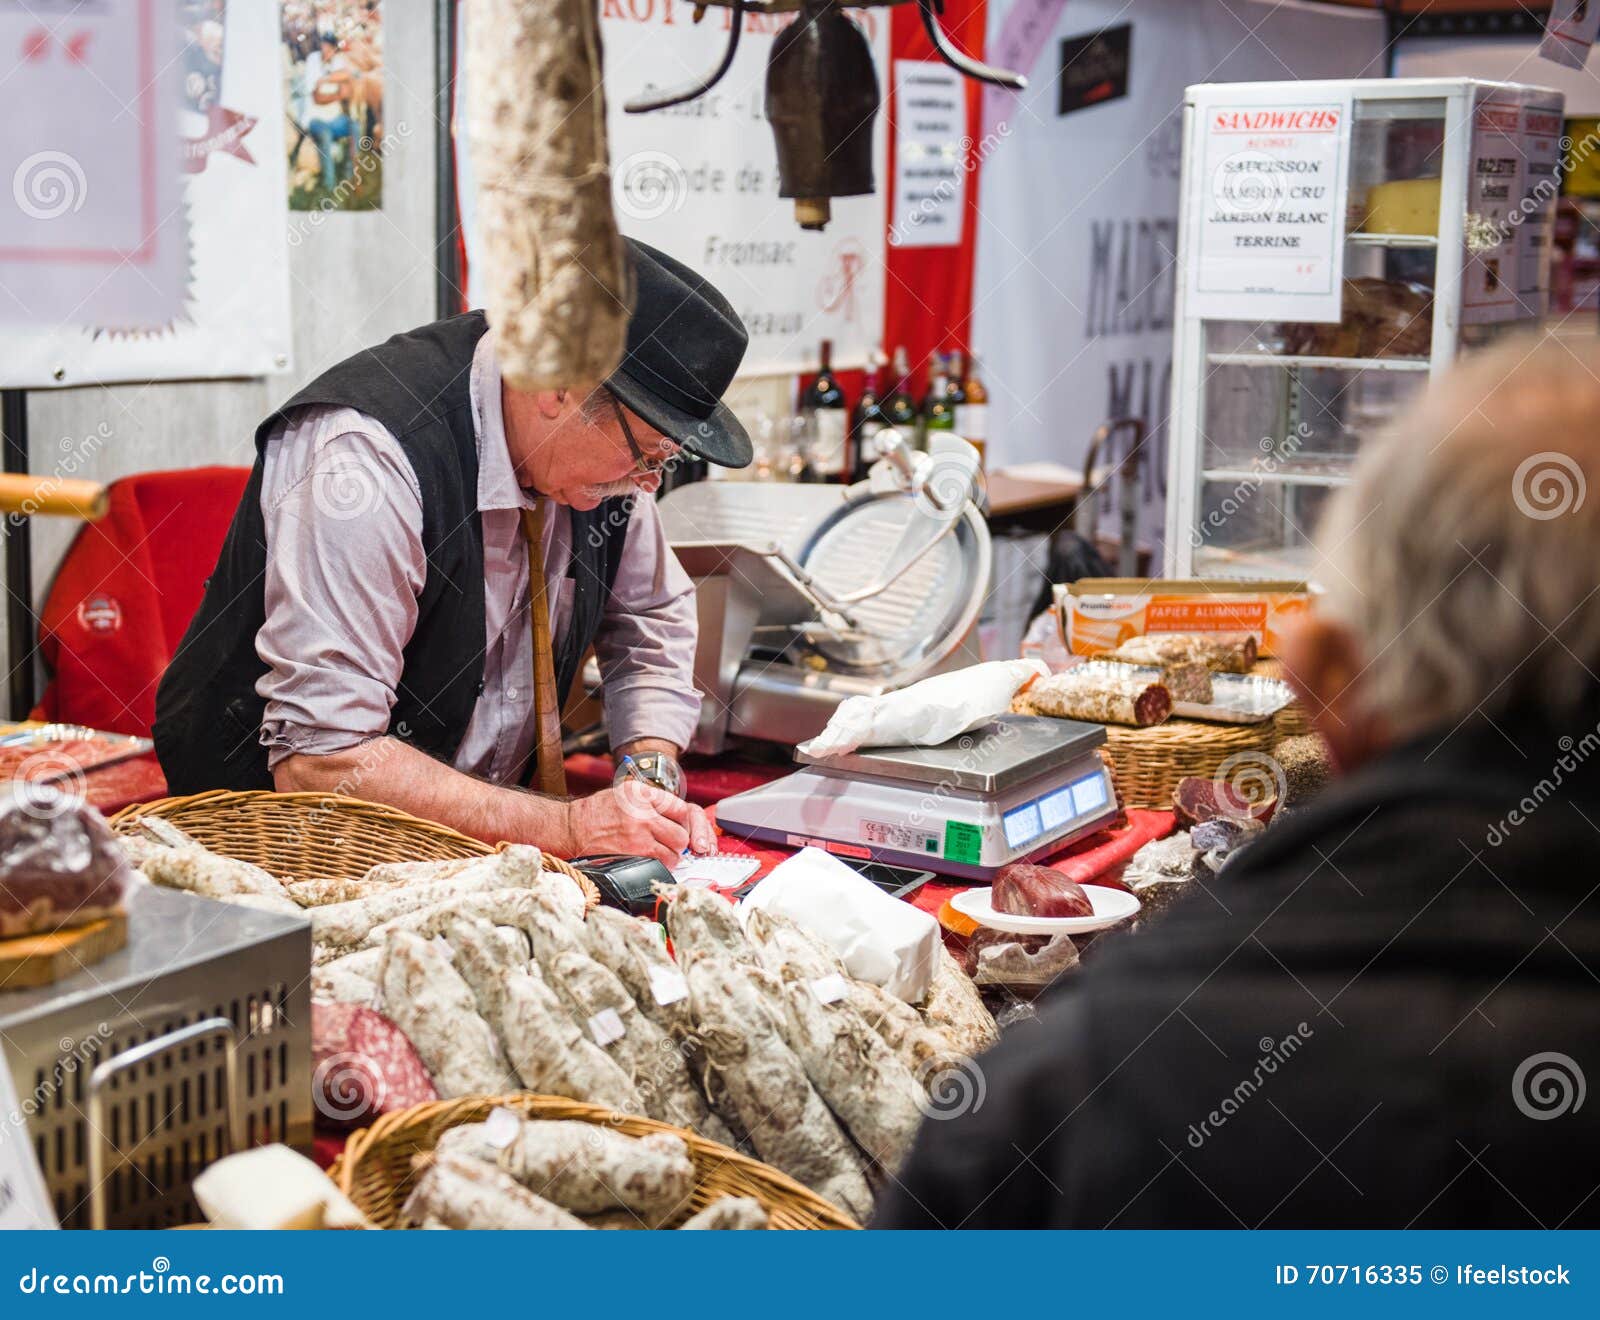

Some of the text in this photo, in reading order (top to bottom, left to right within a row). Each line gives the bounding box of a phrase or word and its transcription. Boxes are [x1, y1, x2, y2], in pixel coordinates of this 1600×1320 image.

[1213, 110, 1341, 130] SANDWICHS
[1224, 160, 1322, 174] SAUCISSON
[1290, 186, 1326, 200] CRU
[1209, 211, 1328, 225] JAMBON BLANC
[1234, 235, 1301, 248] TERRINE
[704, 235, 797, 267] Fronsac
[1151, 606, 1262, 618] PAPIER ALUMINIUM
